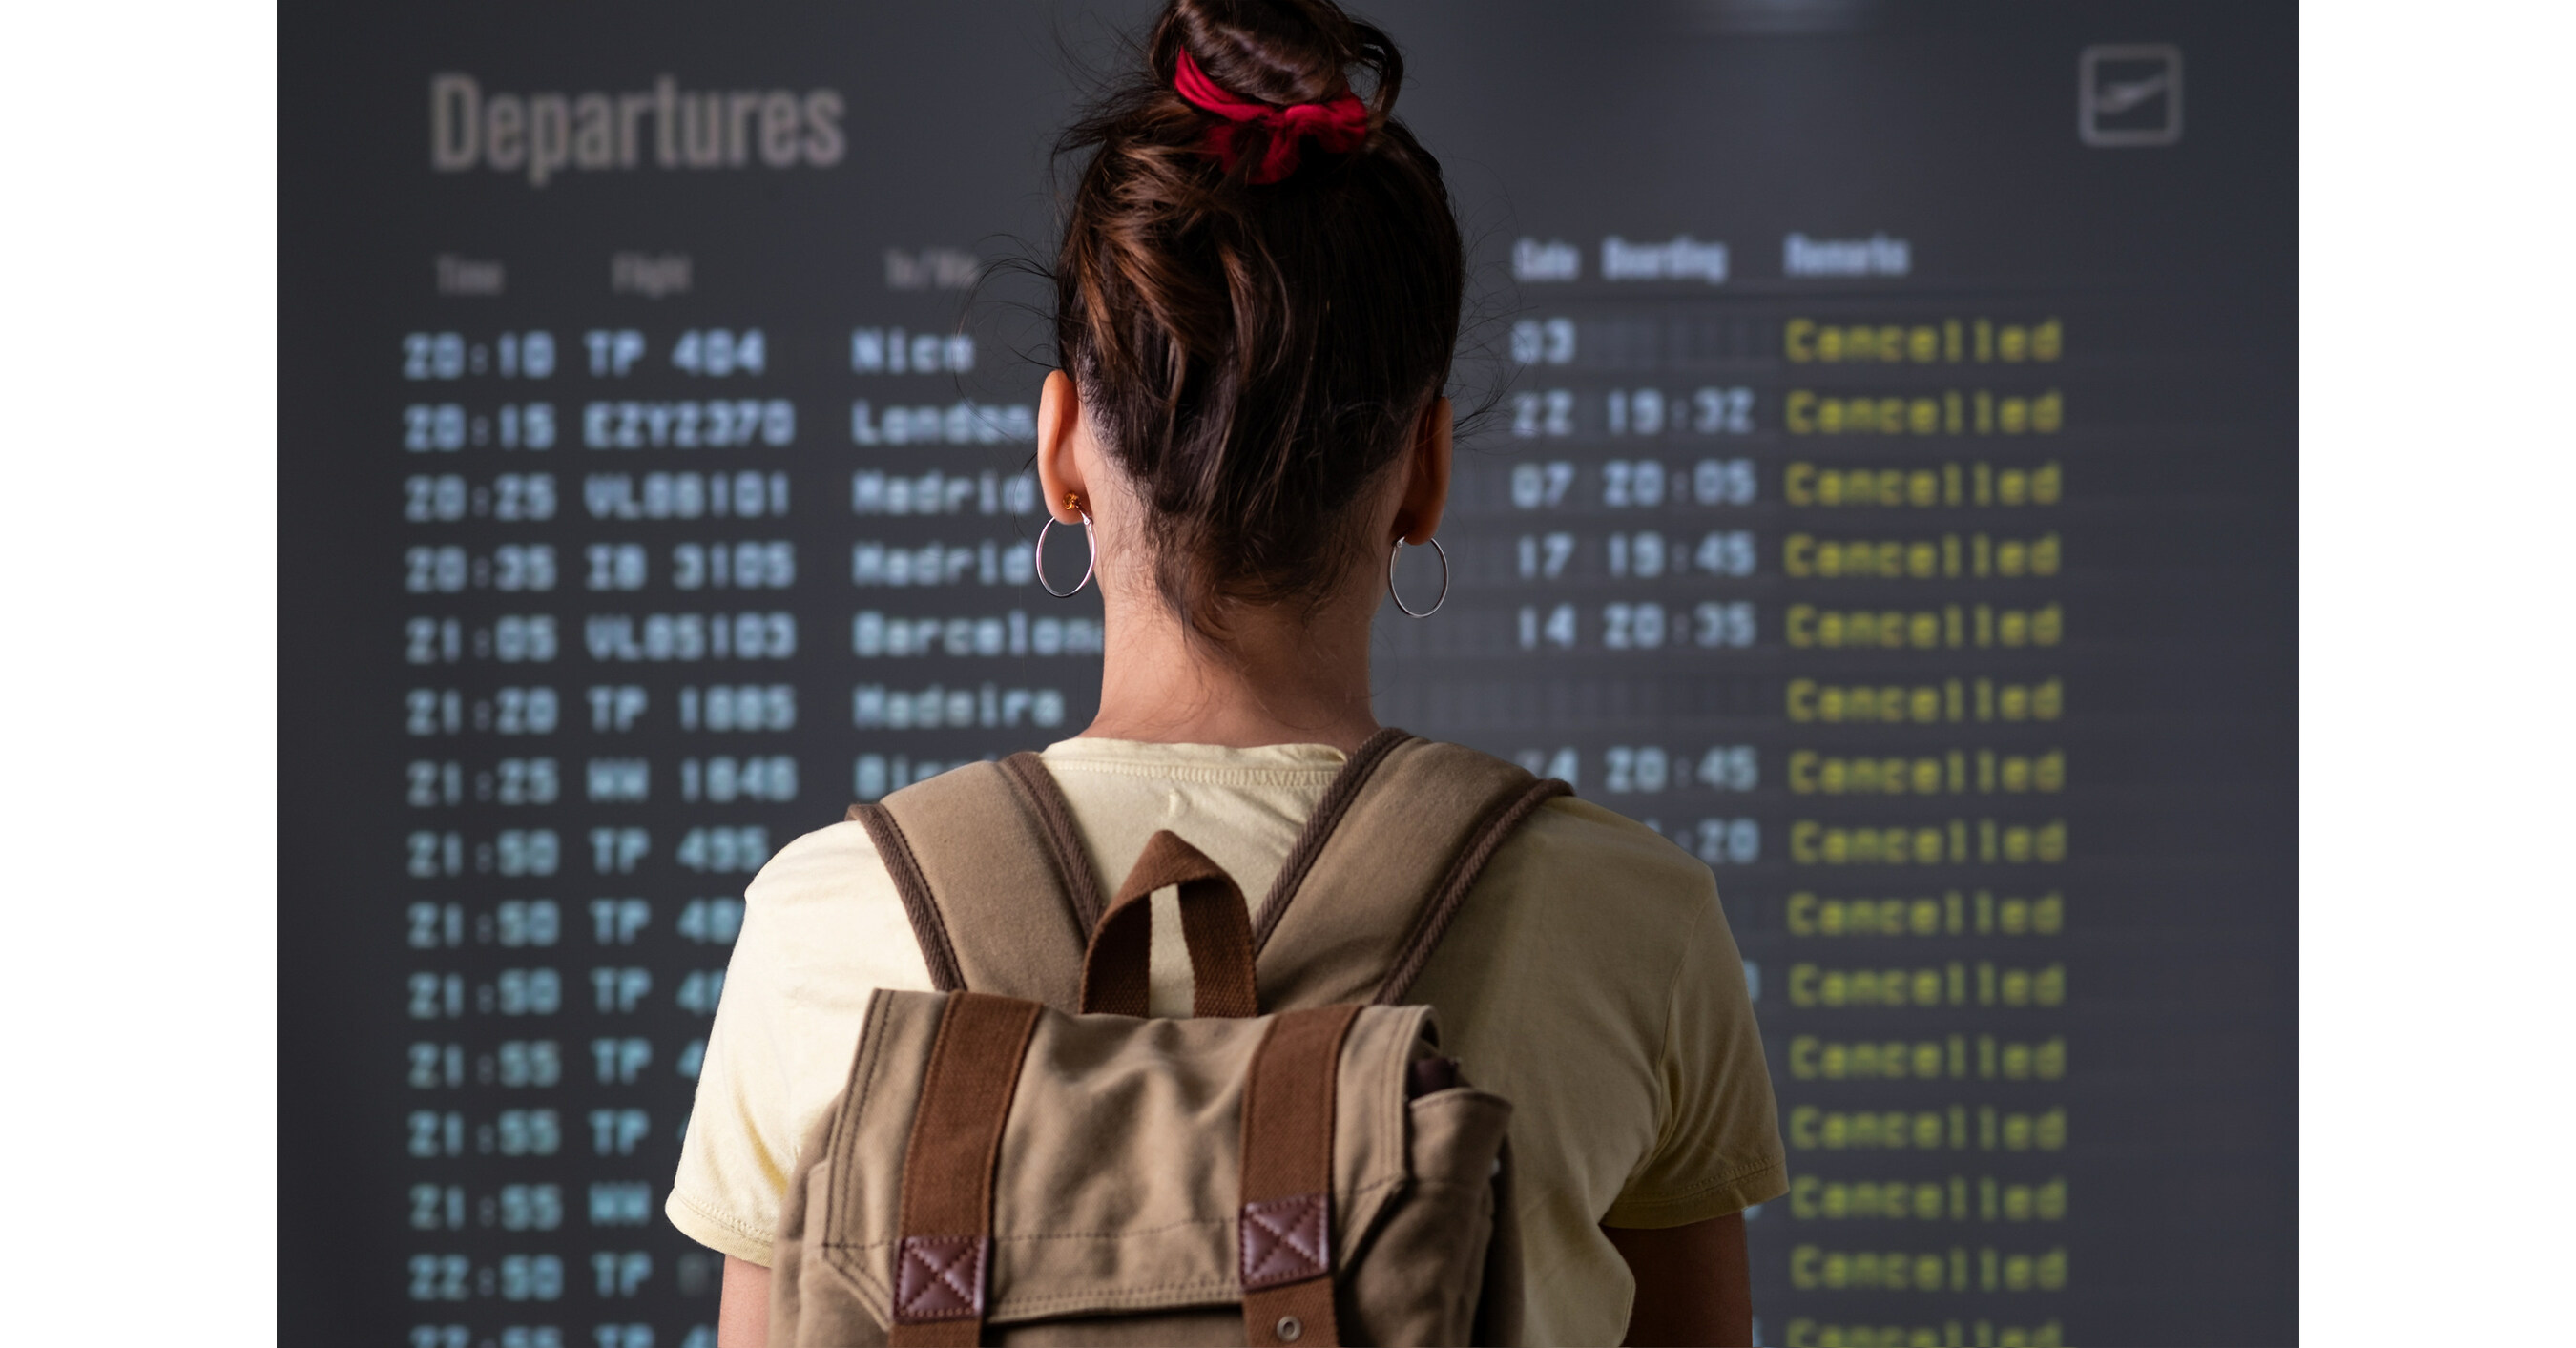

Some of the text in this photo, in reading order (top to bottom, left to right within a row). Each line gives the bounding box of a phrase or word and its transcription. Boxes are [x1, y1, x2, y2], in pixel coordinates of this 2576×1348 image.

[431, 73, 849, 187] Departures
[1601, 236, 1728, 284] Boarding
[1783, 233, 1911, 278] Remarks
[403, 330, 557, 380] 20:10
[585, 329, 646, 375] TP
[851, 328, 975, 375] Nice
[1783, 317, 2063, 364] Cancelled
[404, 402, 557, 452] 20:15
[851, 400, 1036, 446] London
[1784, 388, 2064, 436] Cancelled
[405, 472, 558, 522] 20:25
[852, 470, 1035, 516] Madrid
[1510, 461, 1575, 510] 07
[1602, 458, 1757, 508] 20:05
[1783, 461, 2063, 508] Cancelled
[405, 543, 558, 593] 20:35
[852, 539, 1033, 587] Madrid
[1517, 531, 1575, 579] 17
[1607, 530, 1756, 579] 19:45
[1782, 532, 2062, 580] Cancelled
[406, 613, 559, 664] 21:05
[1518, 604, 1576, 649] 14
[1603, 601, 1756, 651] 20:35
[1784, 603, 2063, 650] Cancelled
[406, 686, 560, 736] 21:20
[588, 685, 648, 730] TP
[852, 683, 1065, 730] Madeira
[1784, 677, 2064, 724] Cancelled
[407, 757, 560, 807] 21:25
[1605, 745, 1758, 795] 20:45
[1787, 749, 2066, 796] Cancelled
[407, 828, 561, 878] 21:50
[590, 827, 651, 872] TP
[1789, 819, 2067, 866] Cancelled
[407, 899, 561, 948] 21:50
[590, 898, 651, 943] TP
[1785, 890, 2064, 938] Cancelled
[408, 967, 562, 1019] 21:50
[592, 966, 653, 1011] TP
[1787, 962, 2066, 1008] Cancelled
[408, 1039, 562, 1089] 21:55
[592, 1037, 653, 1082] TP
[1788, 1034, 2067, 1081] Cancelled
[408, 1108, 561, 1158] 21:55
[590, 1109, 651, 1153] TP
[1789, 1104, 2067, 1151] Cancelled
[410, 1183, 564, 1232] 21:55
[1789, 1174, 2067, 1222] Cancelled
[409, 1254, 564, 1301] 22:50
[592, 1251, 653, 1296] TP
[1789, 1243, 2068, 1292] Cancelled
